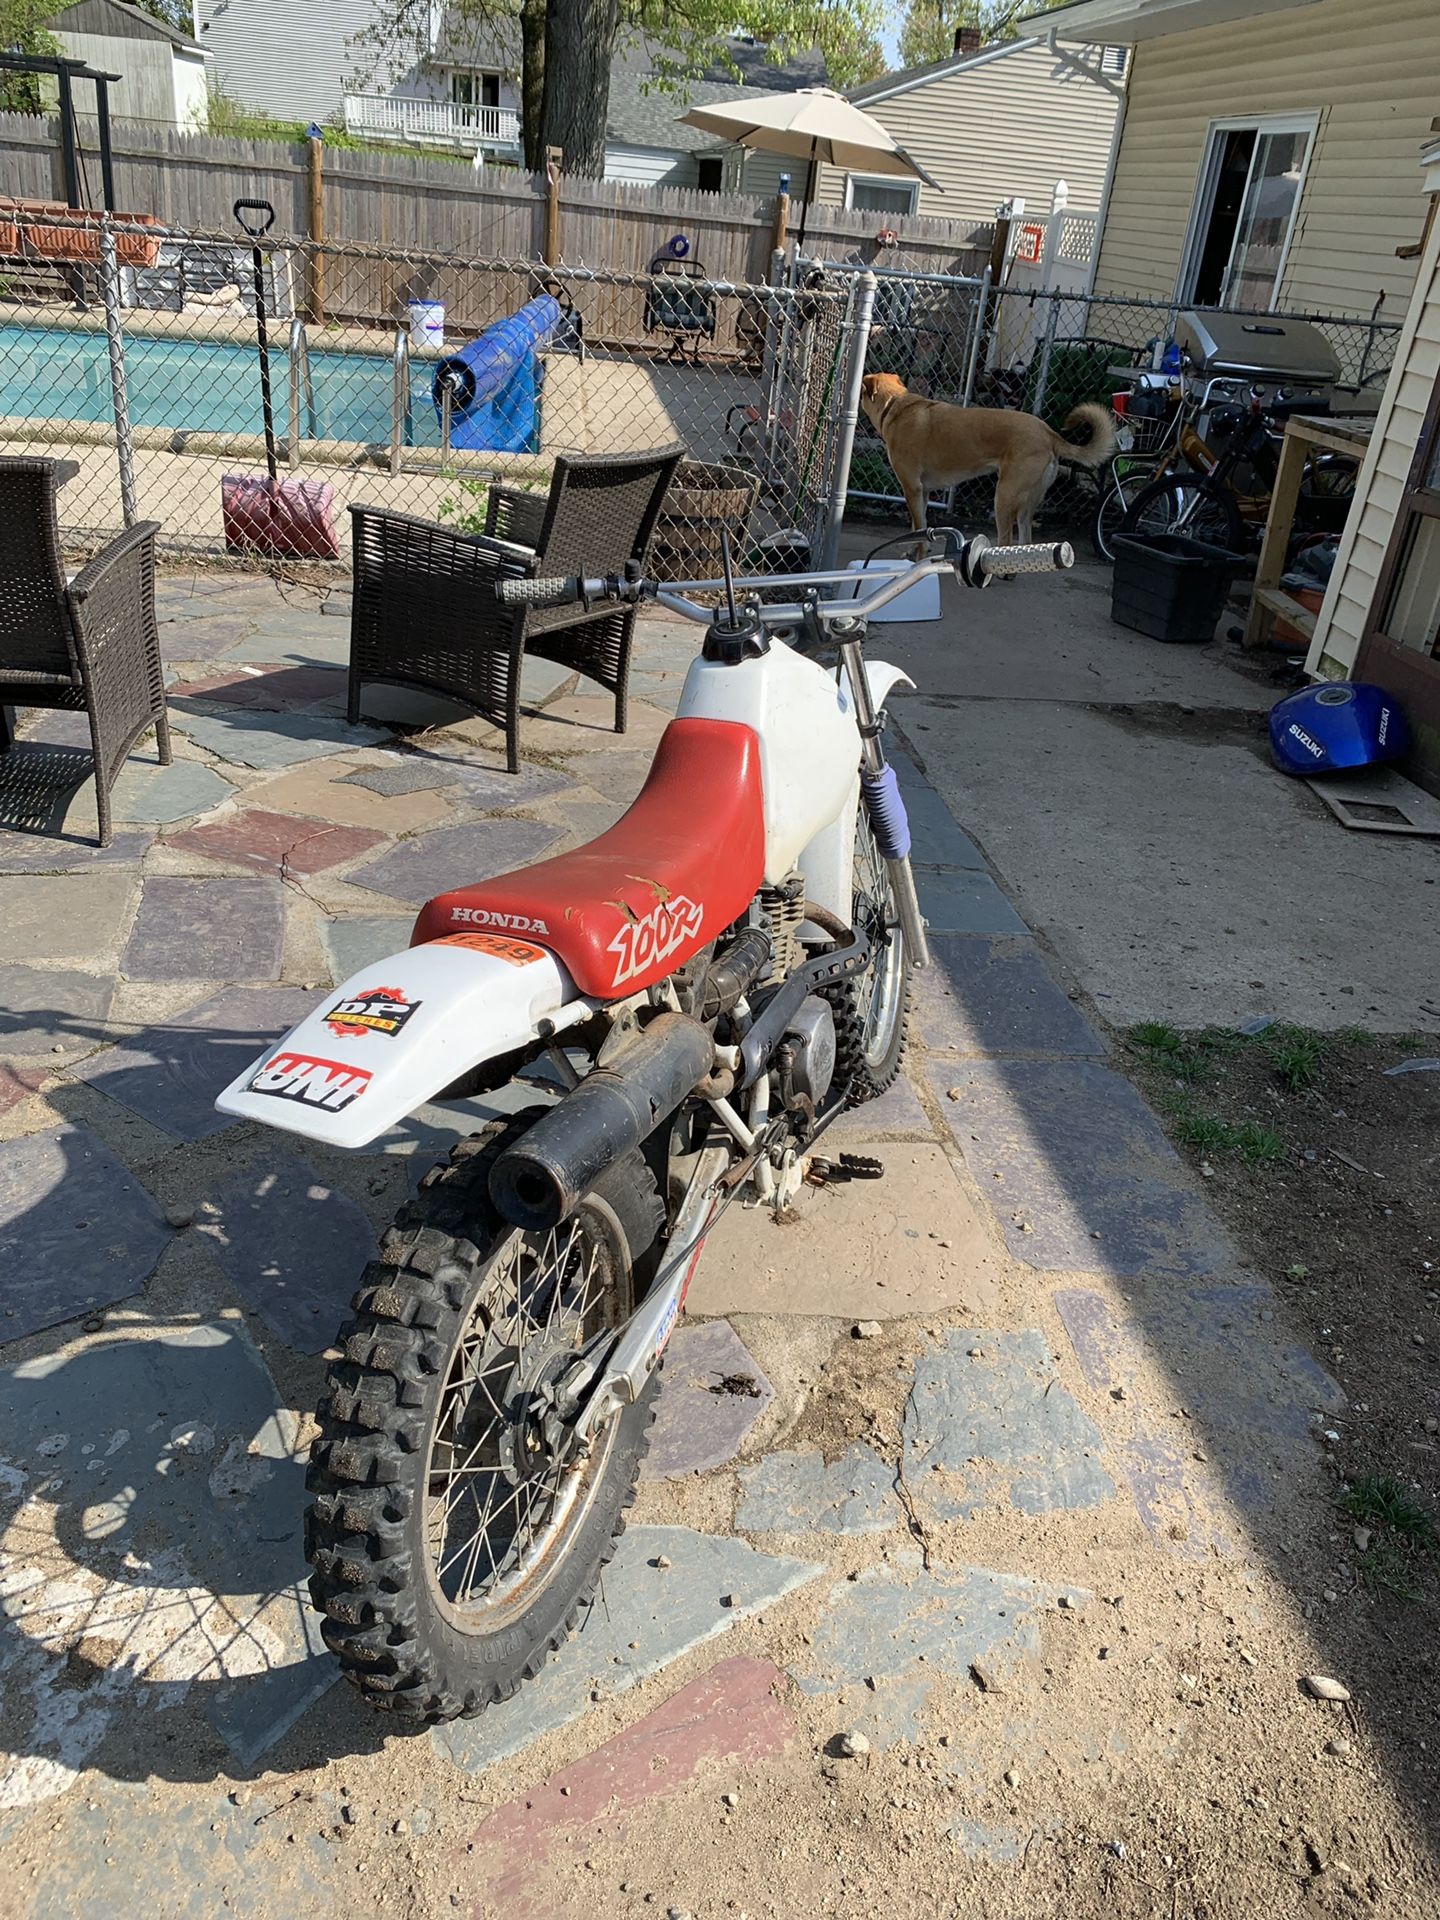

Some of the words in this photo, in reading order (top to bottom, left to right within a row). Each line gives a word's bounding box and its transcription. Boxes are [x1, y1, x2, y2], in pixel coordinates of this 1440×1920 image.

[1289, 723, 1323, 758] SUZUKI
[1379, 707, 1391, 746] SUZUKI
[451, 907, 550, 935] HONDA
[606, 895, 704, 988] 100R
[333, 1002, 410, 1017] DP
[252, 1059, 370, 1108] UNI
